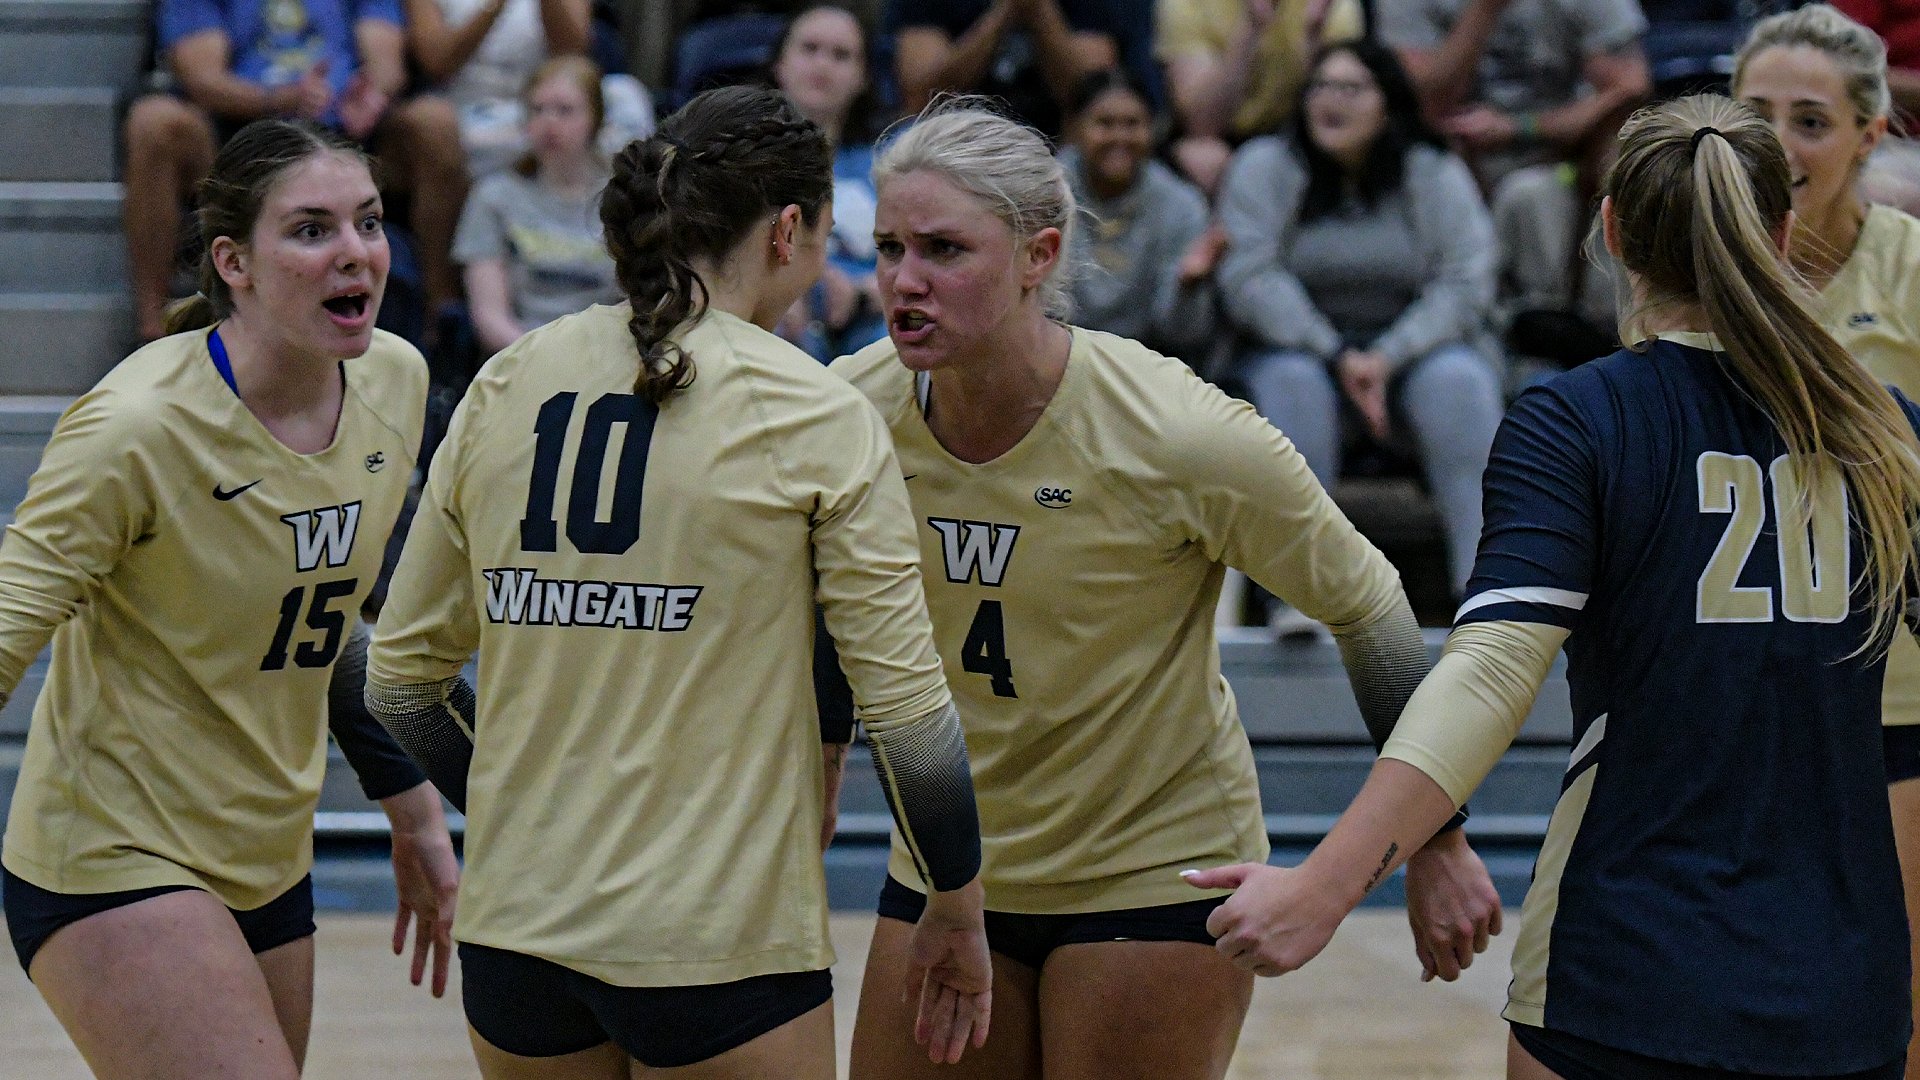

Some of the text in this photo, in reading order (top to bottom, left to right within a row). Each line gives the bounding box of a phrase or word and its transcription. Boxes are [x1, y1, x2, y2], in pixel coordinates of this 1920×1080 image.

[520, 391, 660, 555] 10
[1038, 487, 1072, 504] SAC
[279, 500, 362, 573] W
[927, 516, 1021, 587] W
[1696, 451, 1850, 624] 20
[260, 577, 358, 671] 15
[482, 567, 704, 632] WINGATE
[961, 600, 1019, 699] 4
